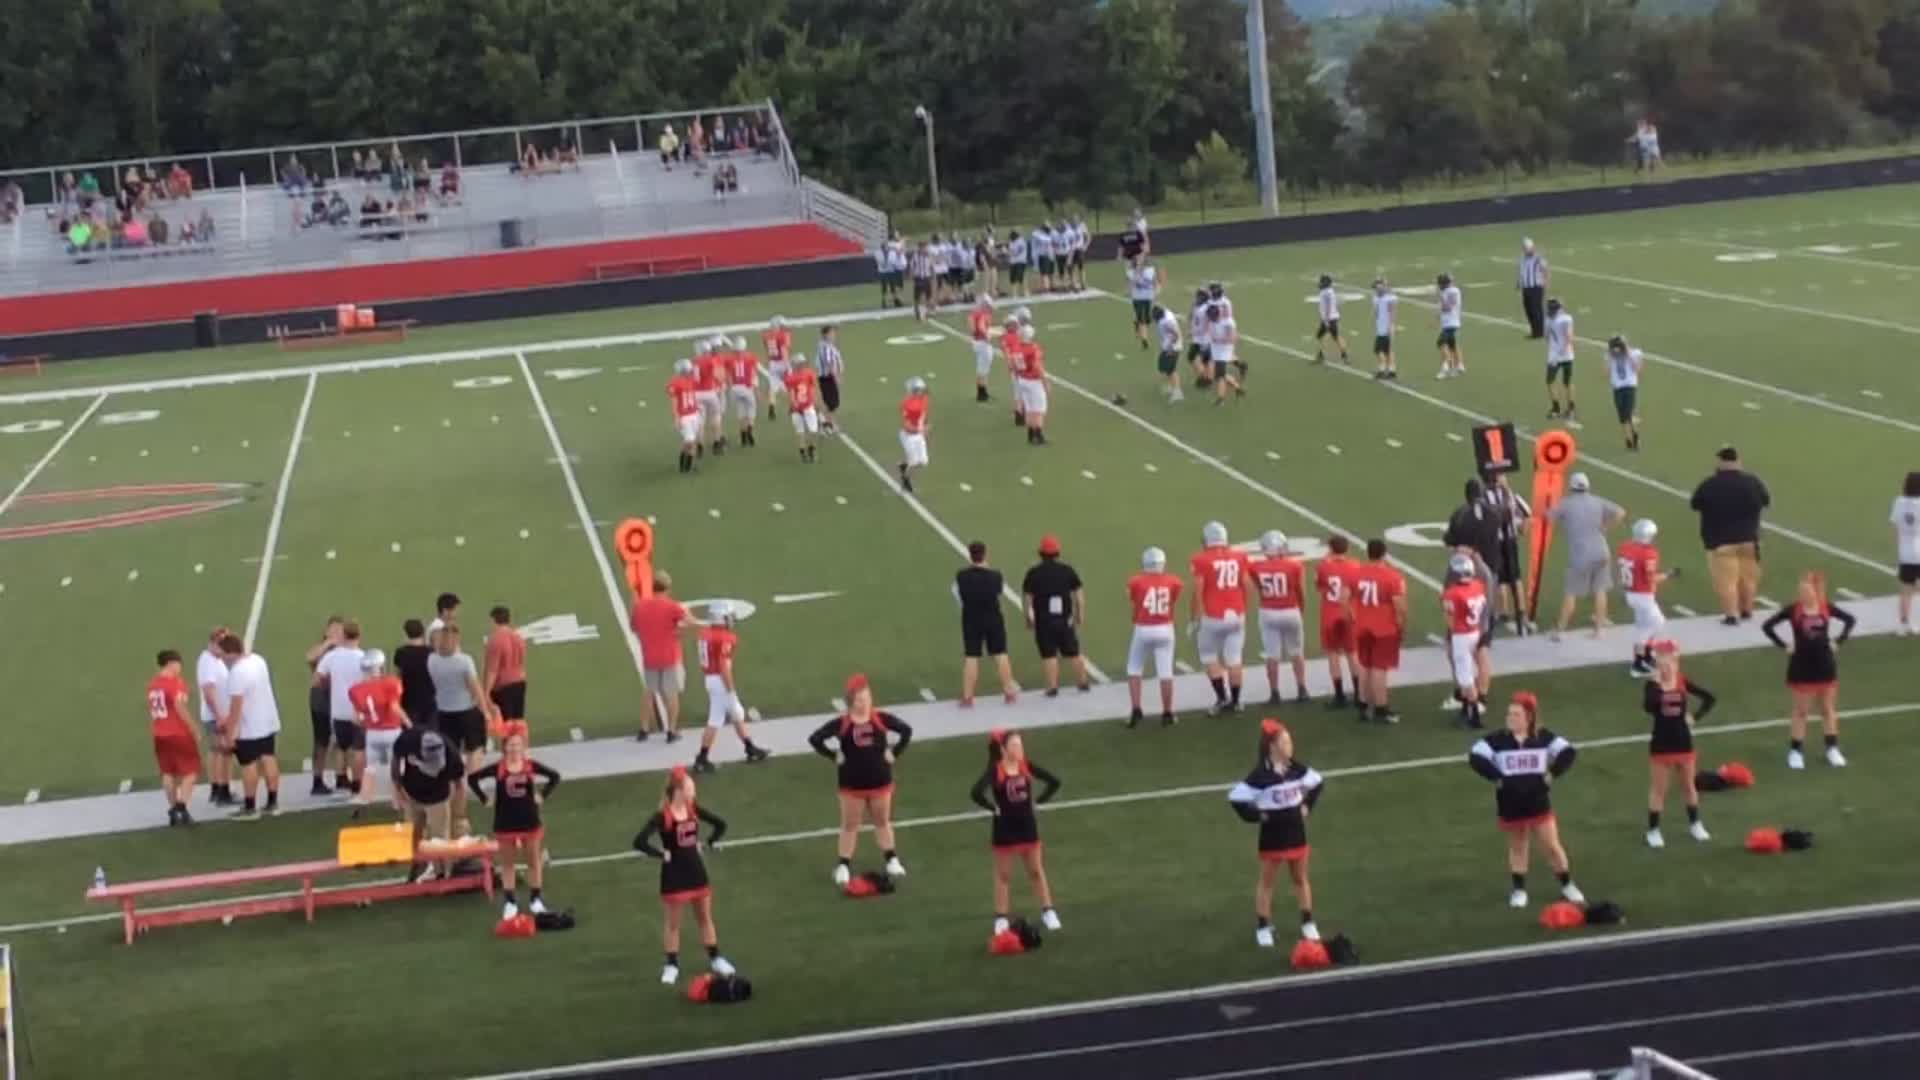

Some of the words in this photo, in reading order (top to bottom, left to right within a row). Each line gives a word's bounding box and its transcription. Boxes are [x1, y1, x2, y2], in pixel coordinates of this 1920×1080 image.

[1213, 560, 1240, 589] 78
[1259, 572, 1288, 598] 50
[1142, 587, 1169, 614] 42
[1358, 580, 1379, 607] 71
